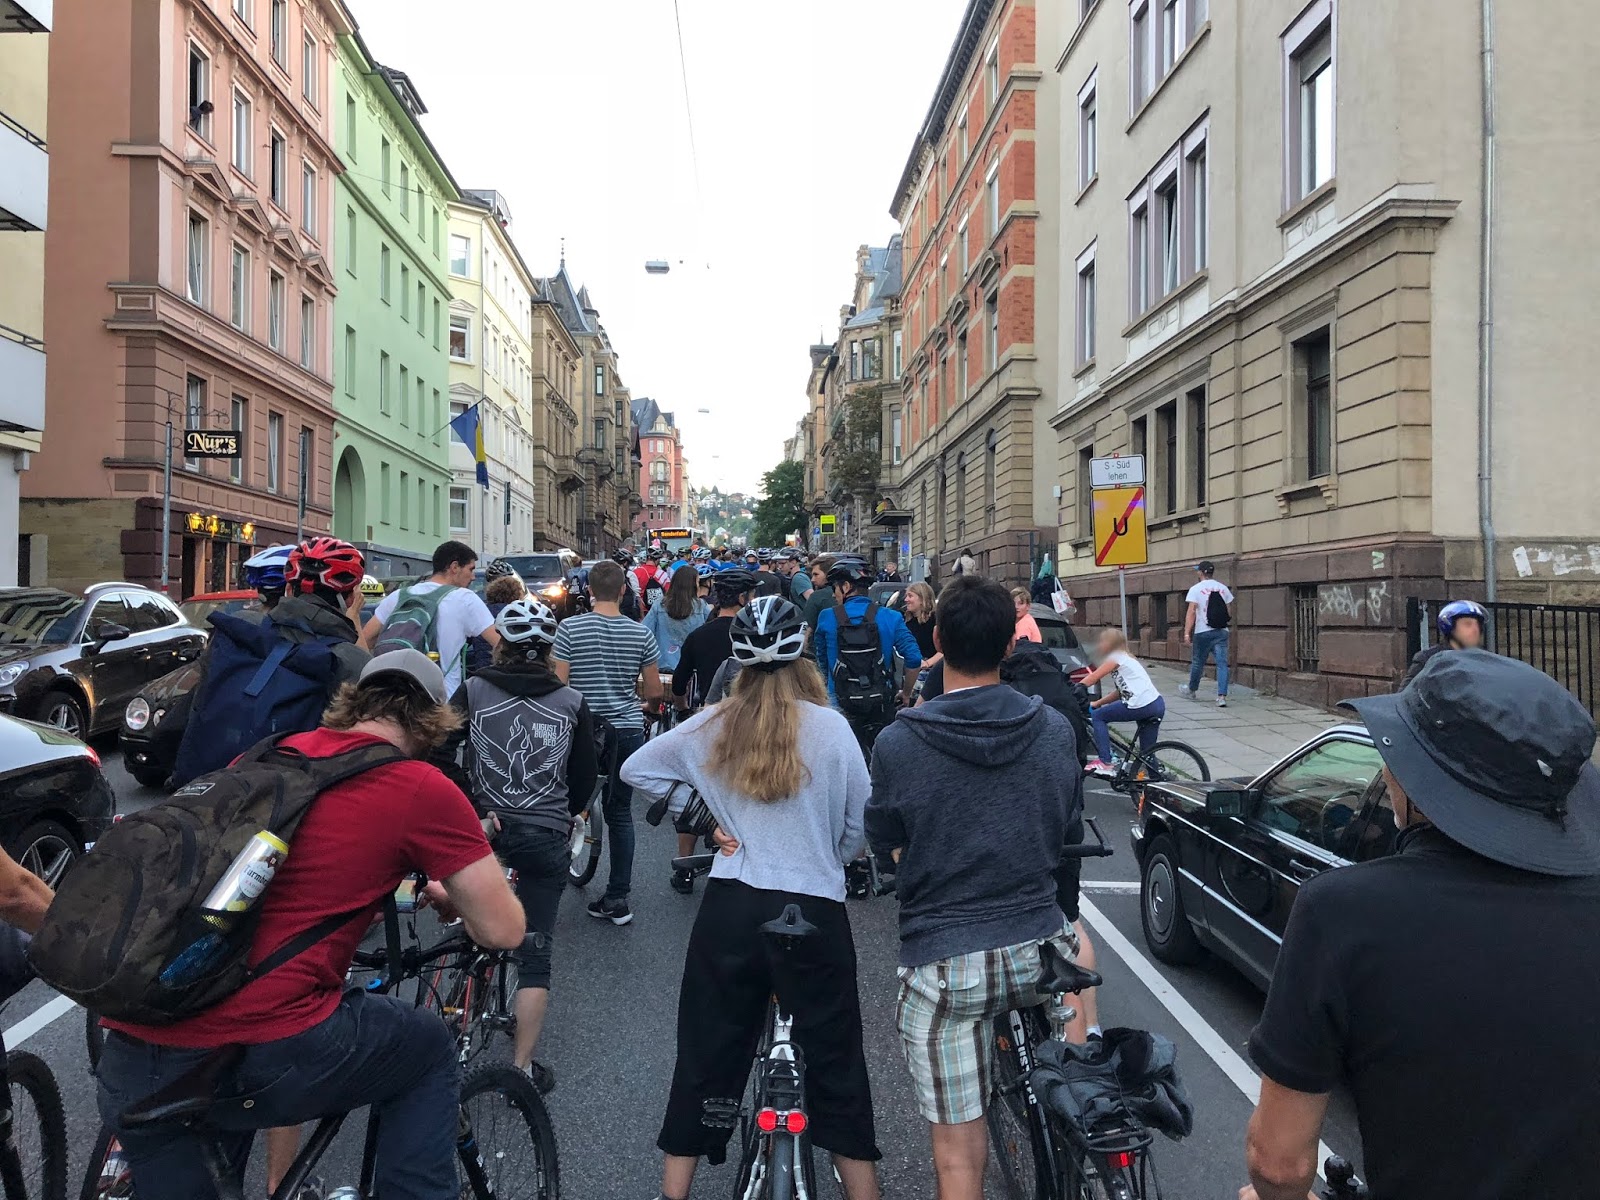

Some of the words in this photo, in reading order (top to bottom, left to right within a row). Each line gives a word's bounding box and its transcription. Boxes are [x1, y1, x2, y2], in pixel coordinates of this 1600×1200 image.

[187, 432, 237, 452] Nur's
[1104, 461, 1110, 470] S
[1116, 459, 1131, 469] Süd
[1113, 517, 1128, 536] U
[532, 722, 557, 733] AUGUST
